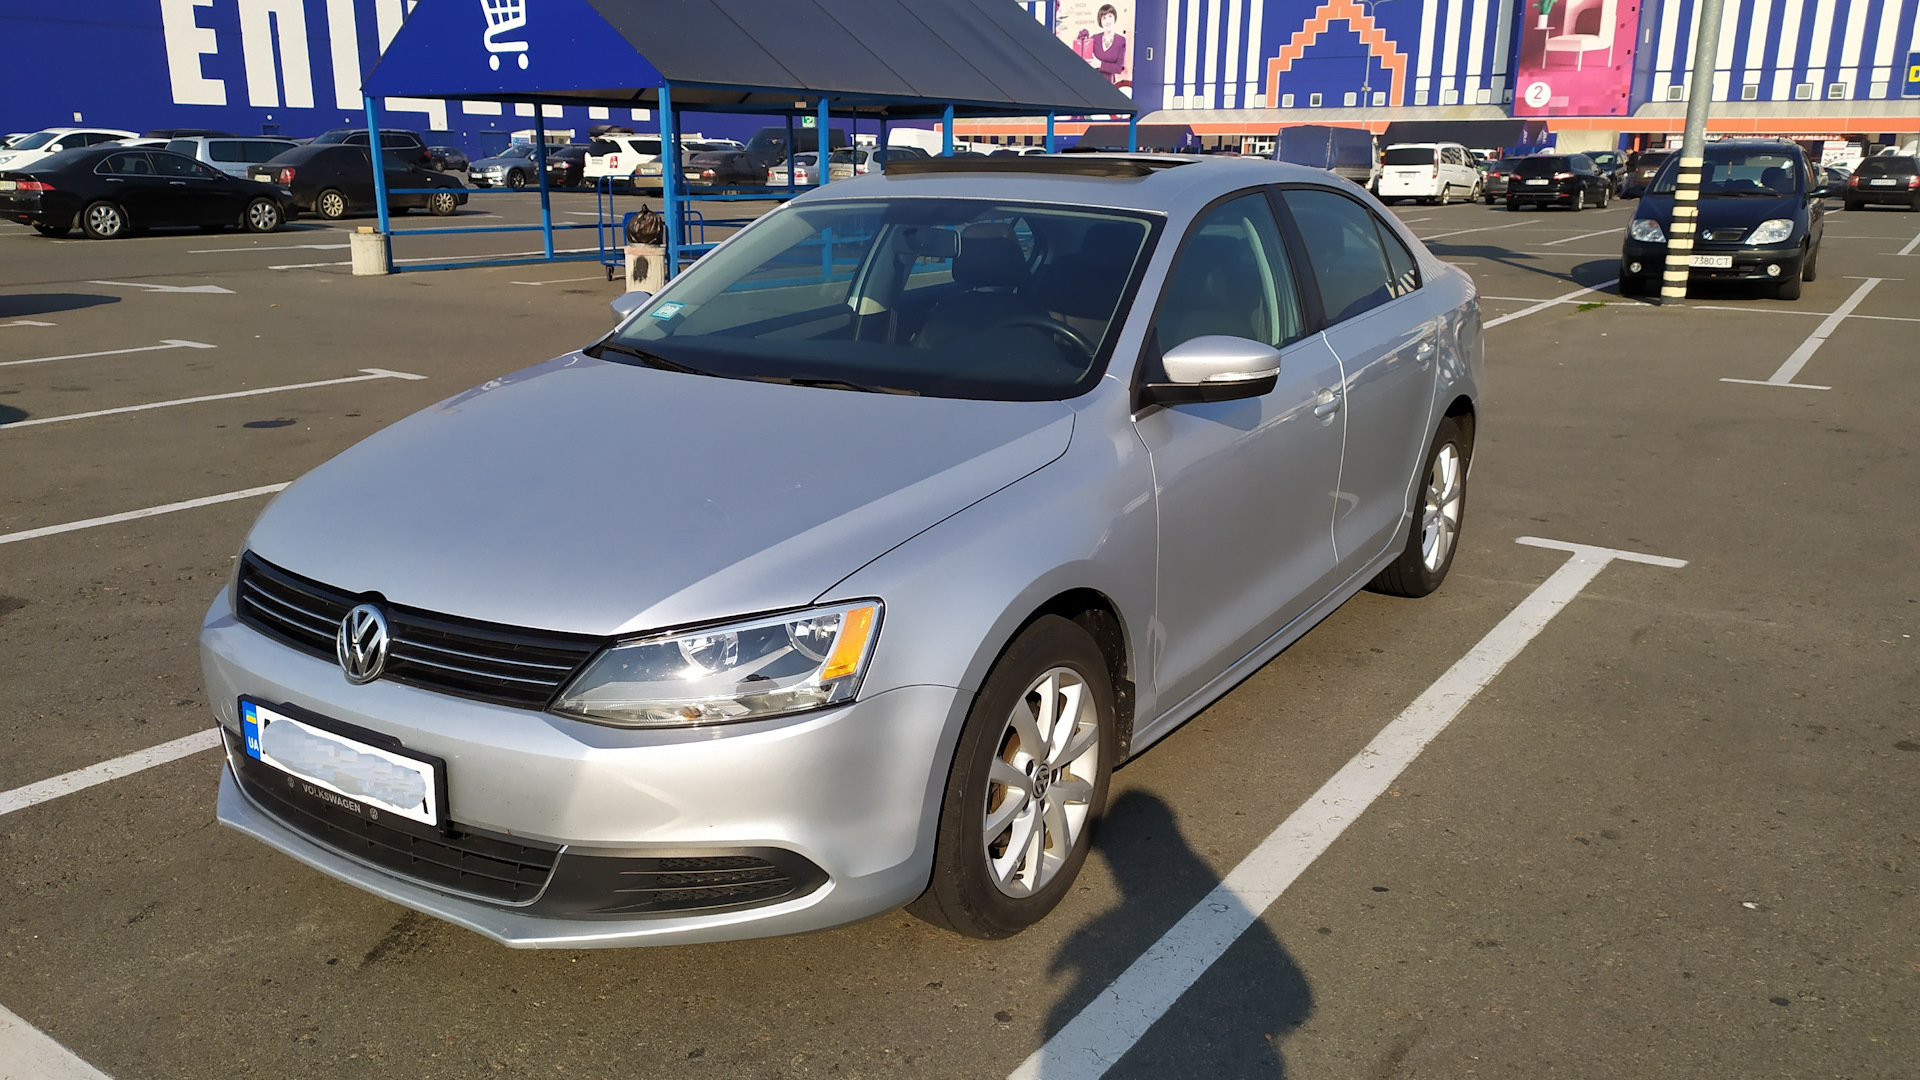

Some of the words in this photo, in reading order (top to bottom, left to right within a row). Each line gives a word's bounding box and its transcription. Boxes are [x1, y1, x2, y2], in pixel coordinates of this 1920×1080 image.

[1533, 85, 1543, 100] 2
[1694, 256, 1714, 266] 7380
[248, 736, 259, 751] UA
[302, 783, 362, 814] VOLKSWAGEN
